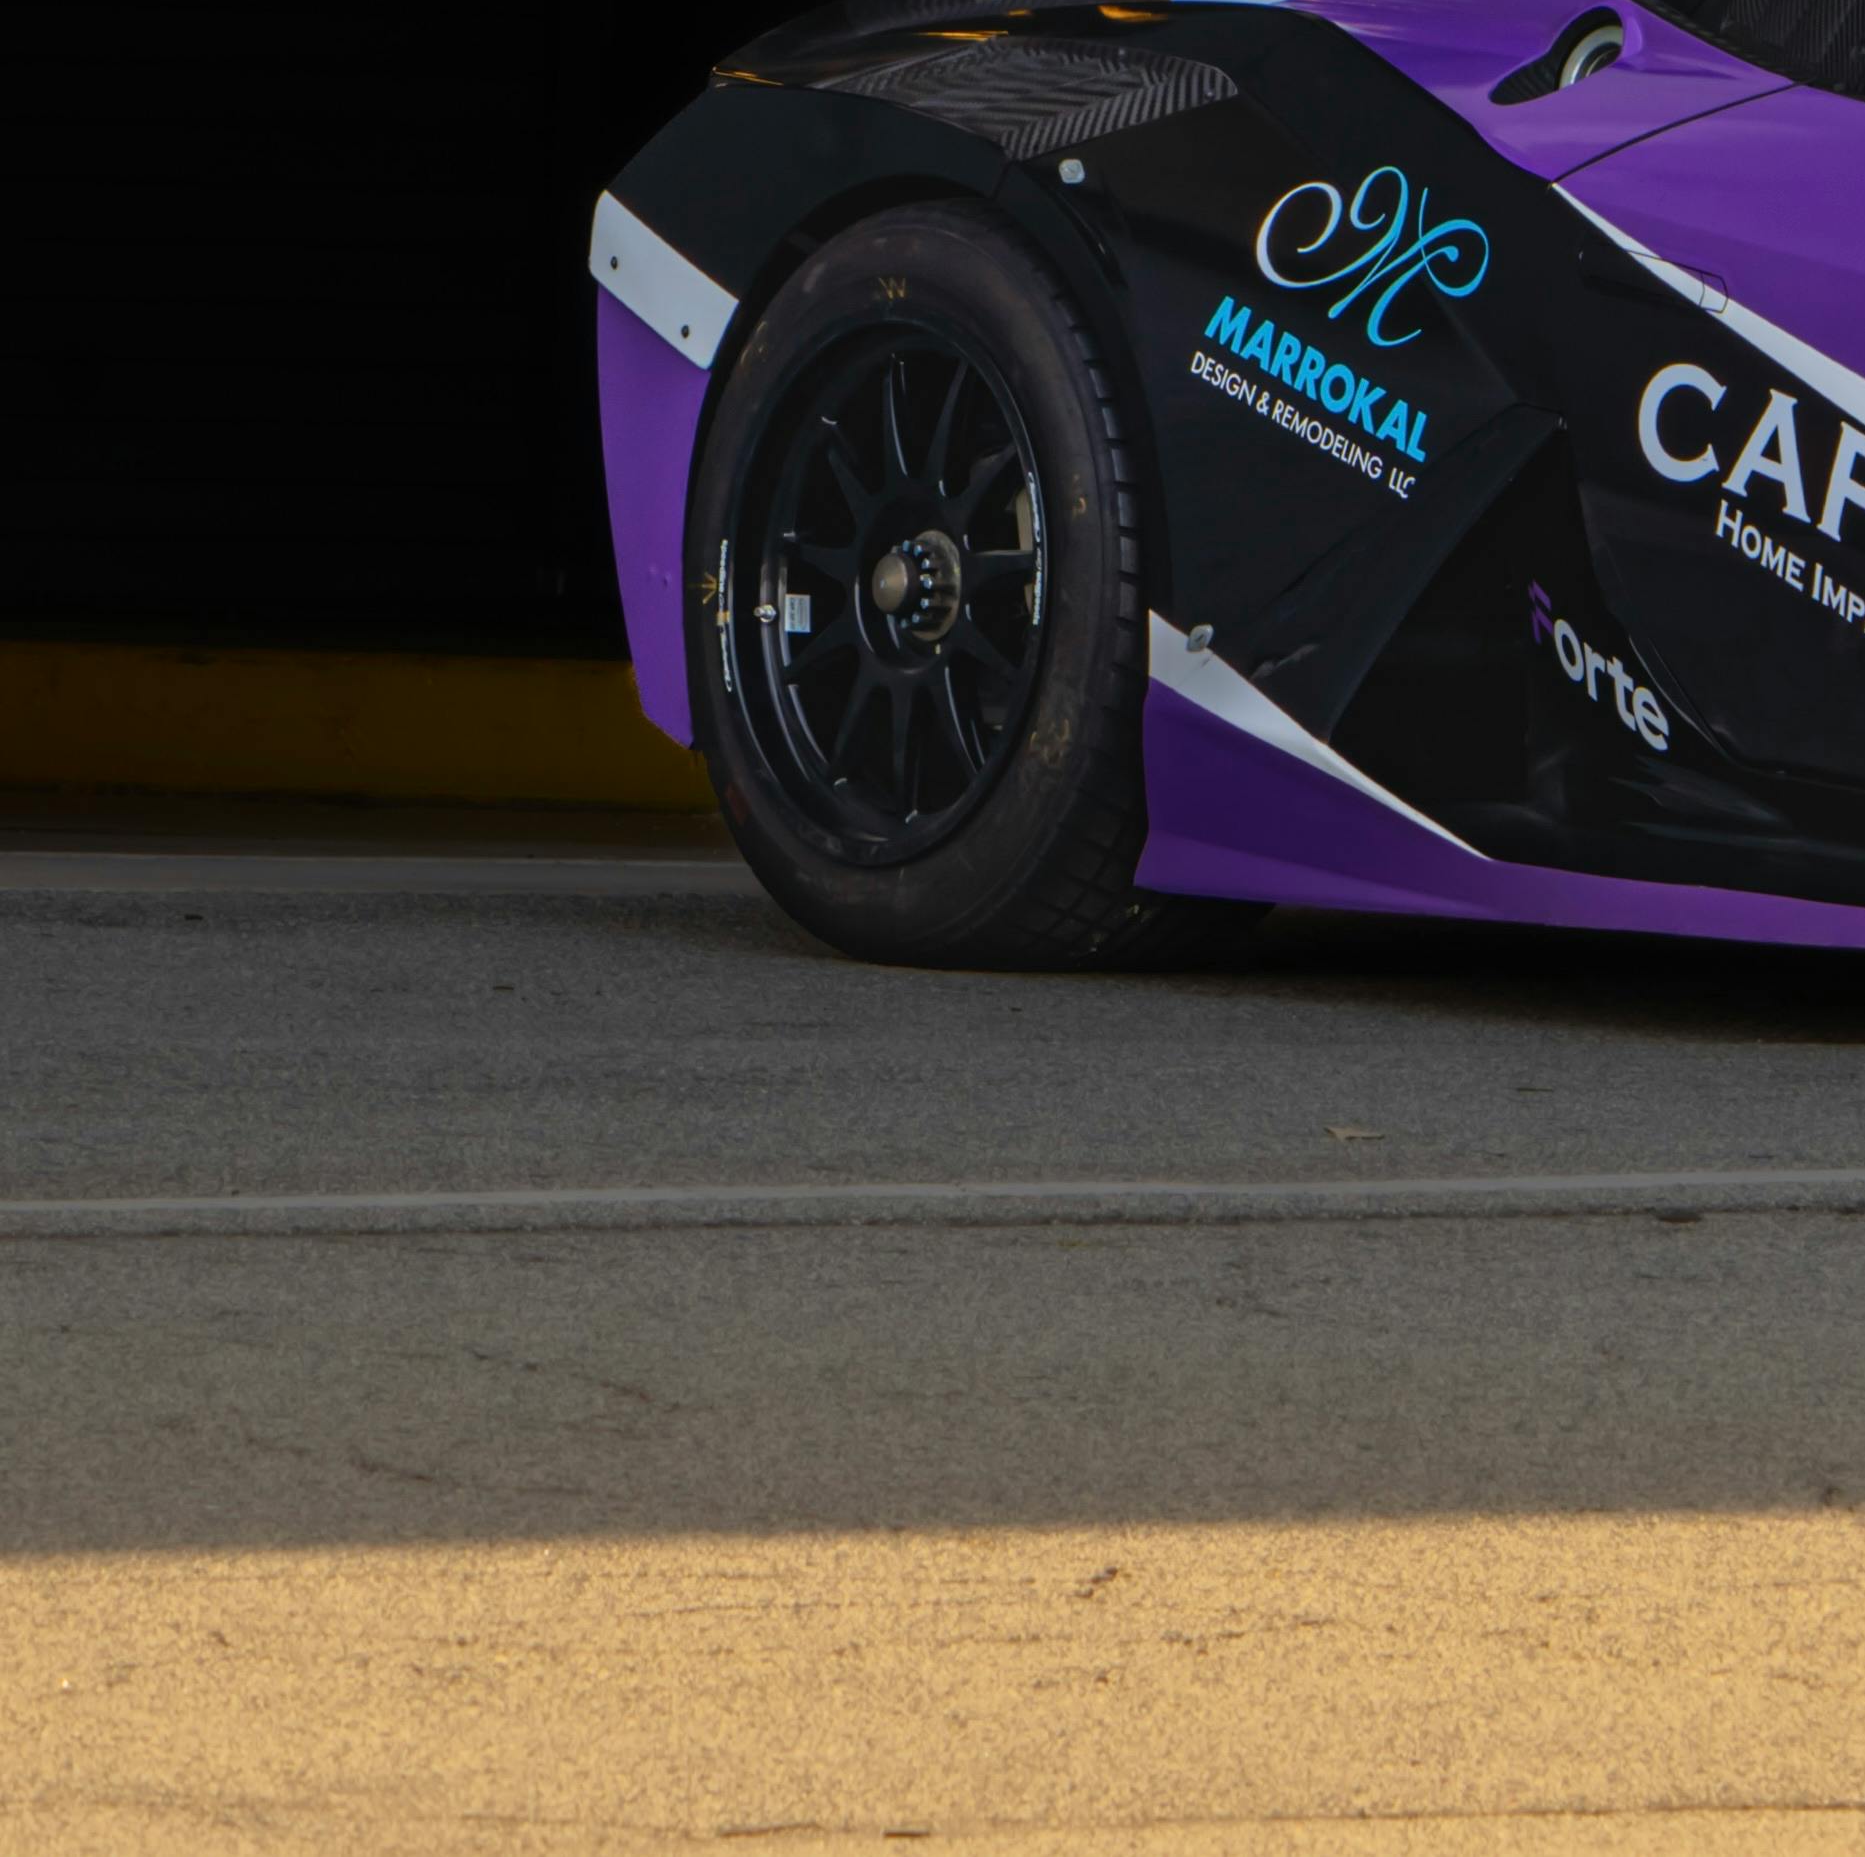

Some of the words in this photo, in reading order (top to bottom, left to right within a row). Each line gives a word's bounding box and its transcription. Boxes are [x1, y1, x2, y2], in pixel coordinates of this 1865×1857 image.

[1189, 350, 1257, 407] DESIGN
[1255, 389, 1271, 417] &
[1270, 399, 1384, 481] REMODELING
[1388, 467, 1417, 500] LLC
[1203, 294, 1429, 463] MARROKAL
